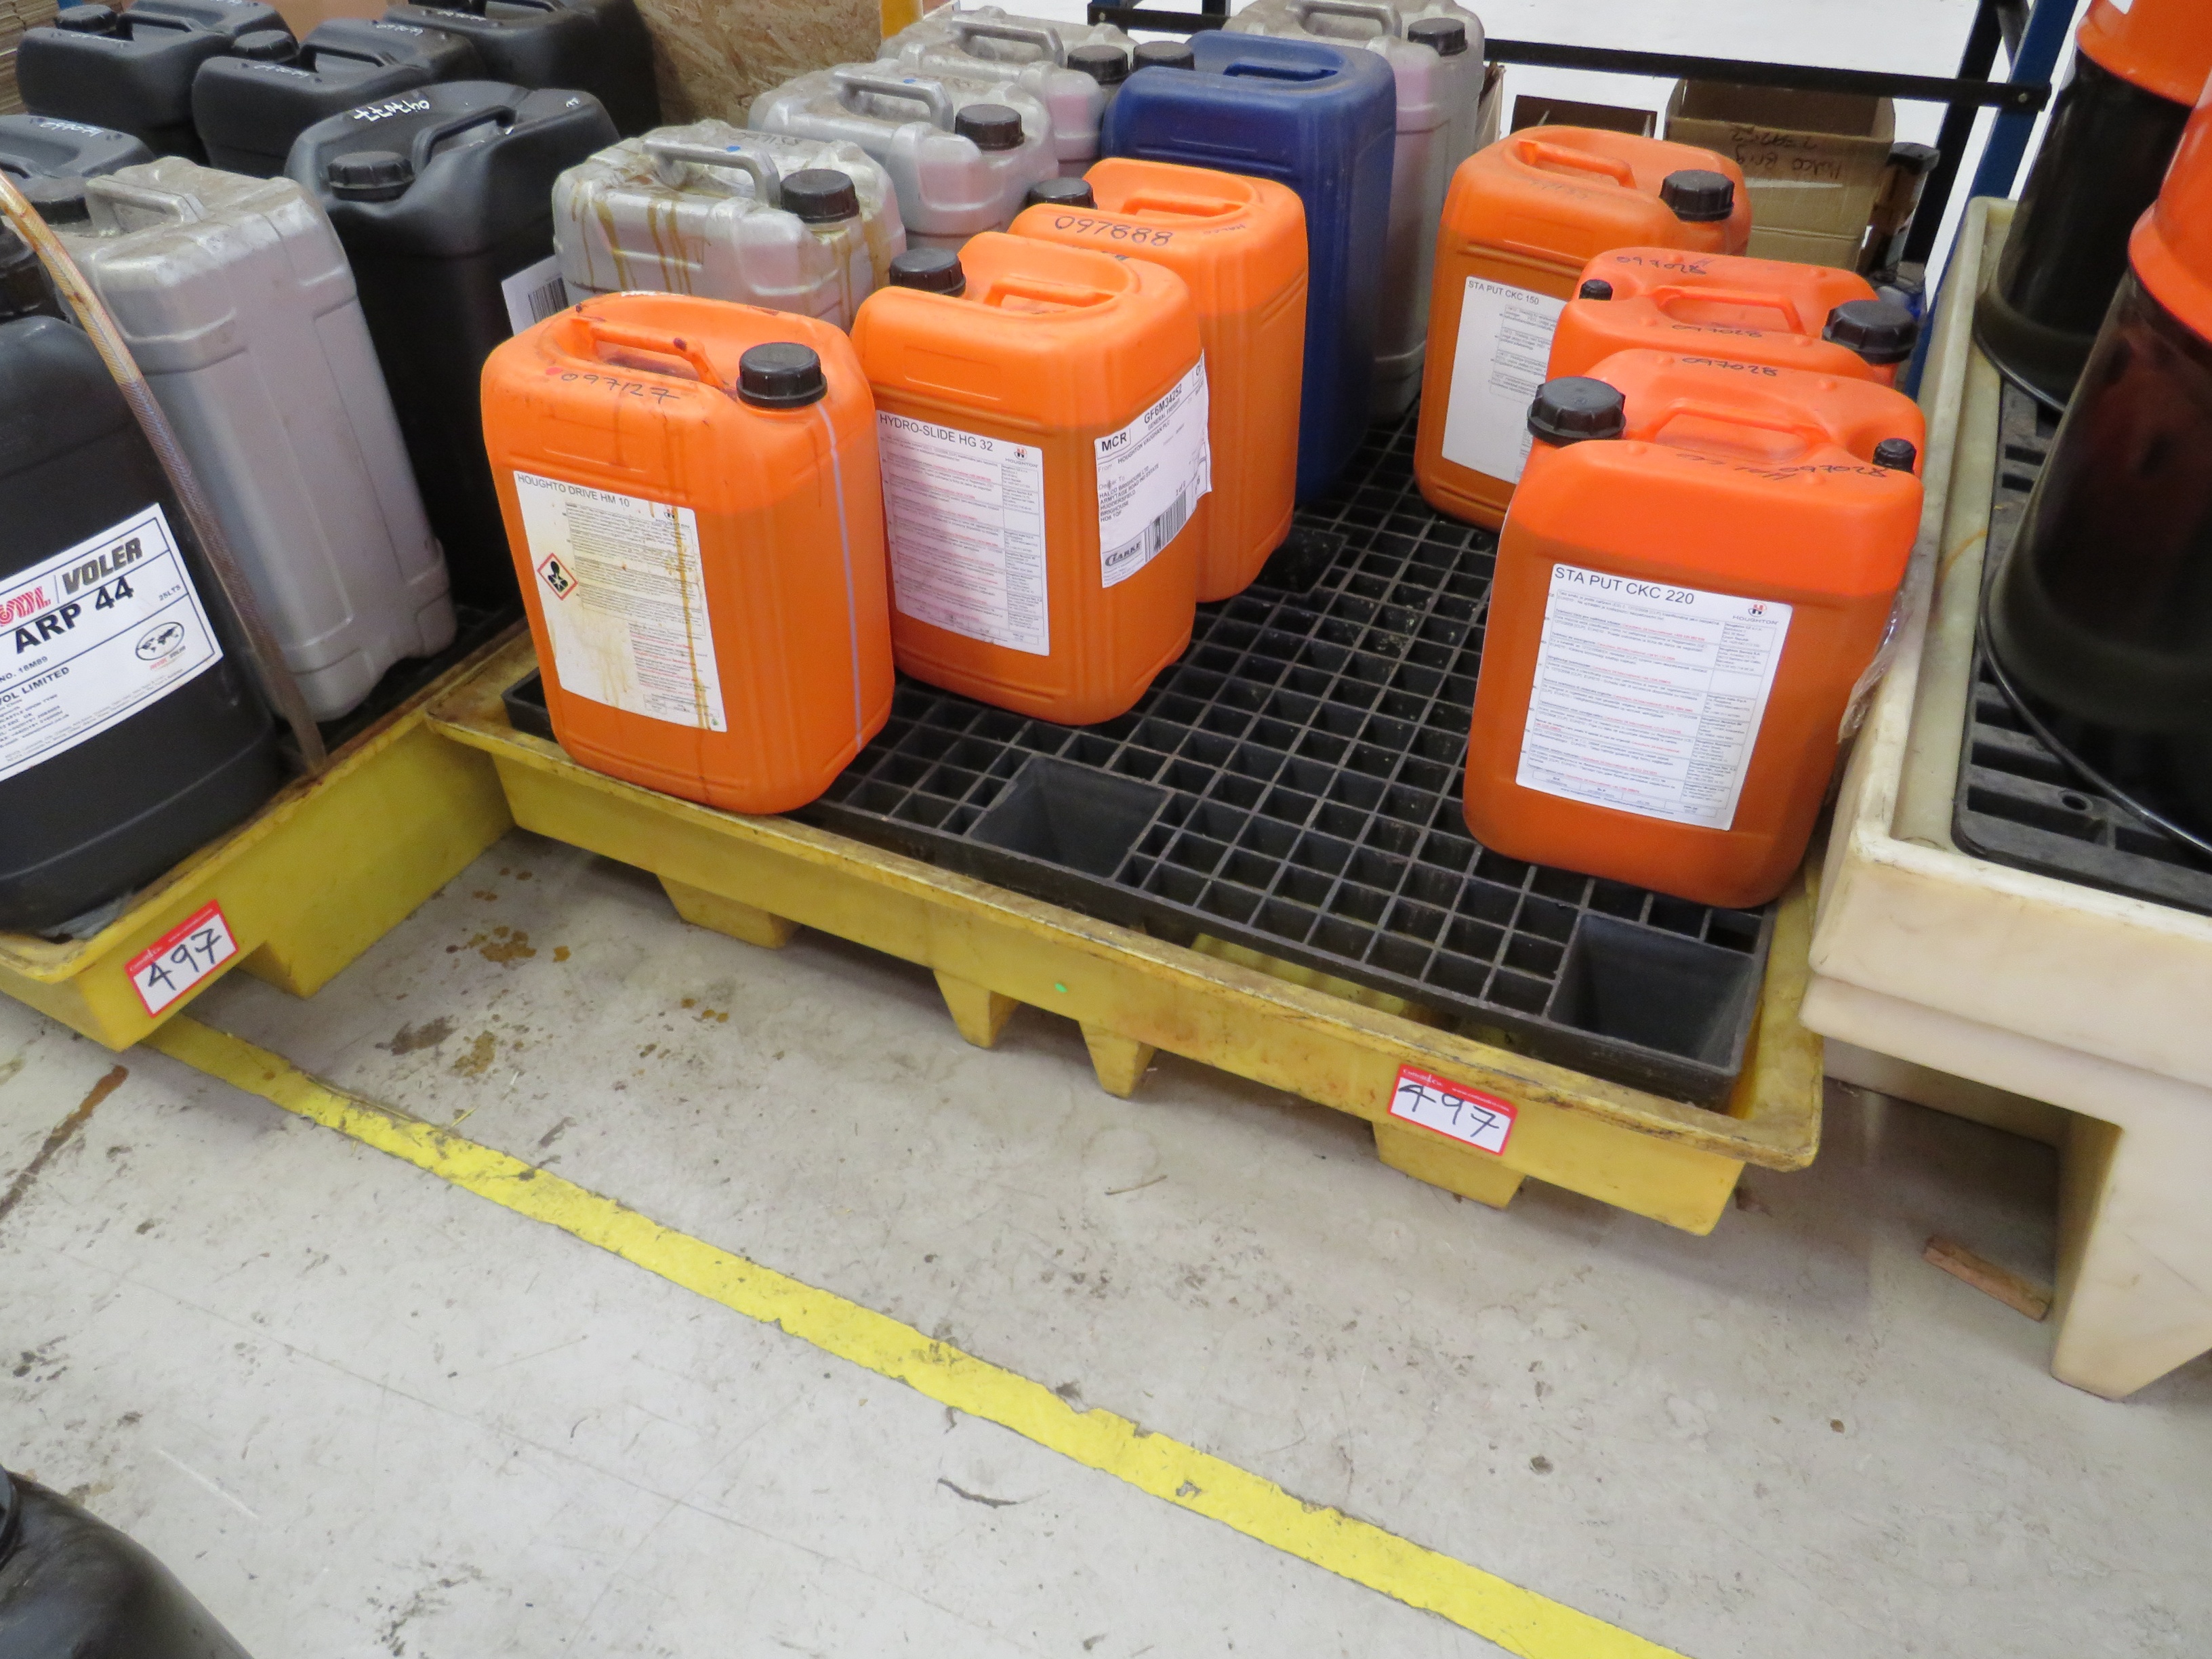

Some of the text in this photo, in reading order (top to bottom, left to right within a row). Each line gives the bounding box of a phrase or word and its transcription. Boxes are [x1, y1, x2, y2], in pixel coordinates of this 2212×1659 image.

[1468, 280, 1540, 306] STA PUT CKC 150
[561, 373, 681, 405] 097127
[1144, 383, 1182, 424] GF6M34252
[880, 413, 994, 452] HYDRO-SLIDE HG 32
[1101, 432, 1128, 452] MCR
[1118, 443, 1143, 464] HOUGHTON
[517, 473, 630, 508] HOUGHTO DRIVE HM 10
[1100, 490, 1136, 510] HUDDERSFIELD
[1100, 501, 1129, 517] BRIGHOUSE
[62, 537, 143, 594] VOLER
[1555, 567, 1694, 605] STA PUT CKC 220
[15, 576, 135, 655] ARP 44
[1732, 615, 1779, 625] HOUGHTON
[0, 667, 70, 705] OL LIMITED
[148, 928, 222, 991] 497
[1398, 1084, 1500, 1137] 497
